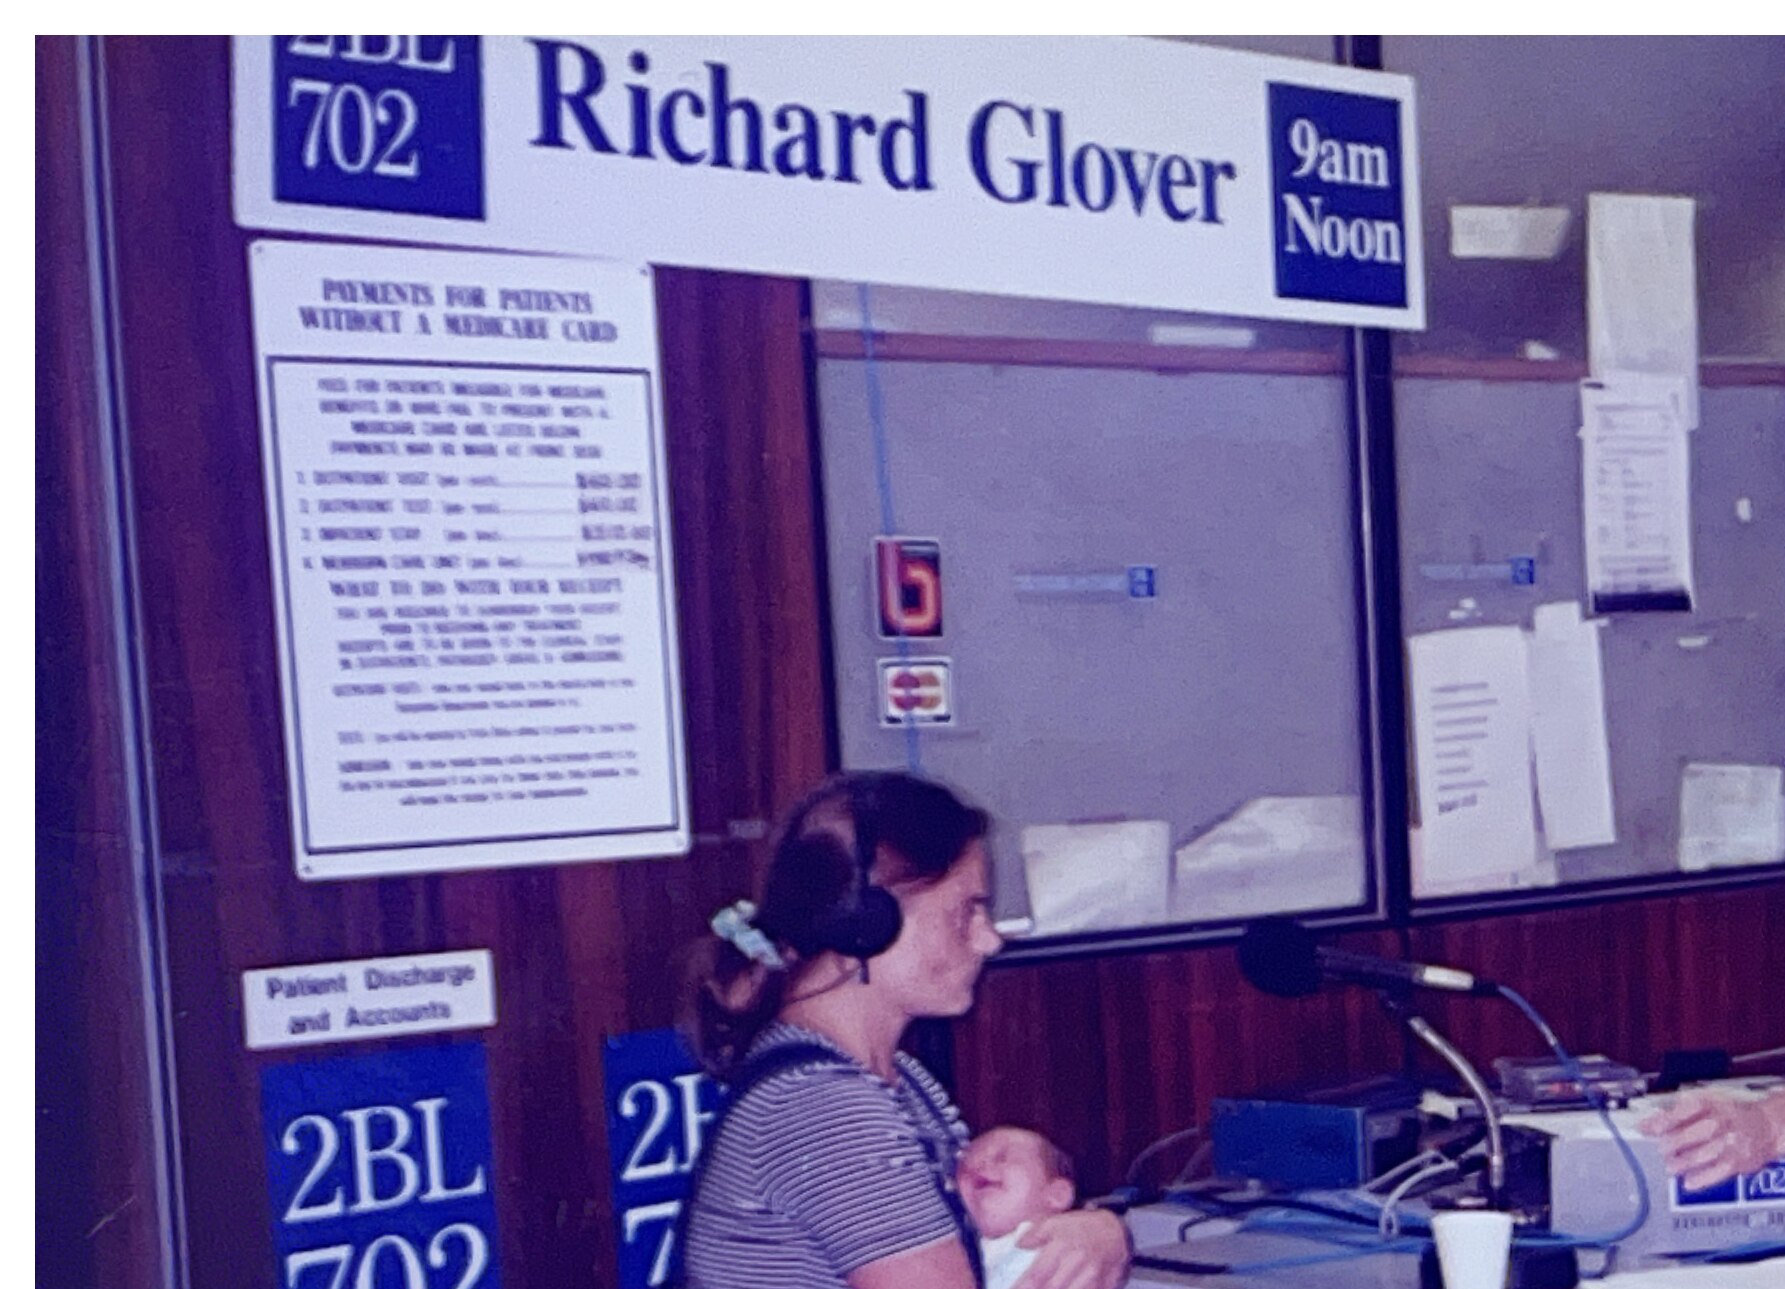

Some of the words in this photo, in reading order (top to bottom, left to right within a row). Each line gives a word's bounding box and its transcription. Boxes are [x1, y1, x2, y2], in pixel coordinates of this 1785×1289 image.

[289, 77, 419, 179] 702
[525, 37, 936, 192] Richard
[967, 99, 1238, 225] Glover
[1289, 118, 1390, 189] 9am
[1282, 192, 1400, 264] Noon
[300, 305, 401, 333] WITHOUT
[444, 312, 549, 341] MEDICARE
[560, 319, 618, 343] CARD
[322, 278, 434, 307] PAYMENTS
[445, 285, 486, 309] FOR
[499, 288, 593, 314] PATIENTS
[266, 974, 348, 999] Patient
[364, 965, 476, 992] Discharge
[289, 1009, 330, 1035] and
[345, 1001, 452, 1028] Accounts
[281, 1097, 487, 1224] 2BL
